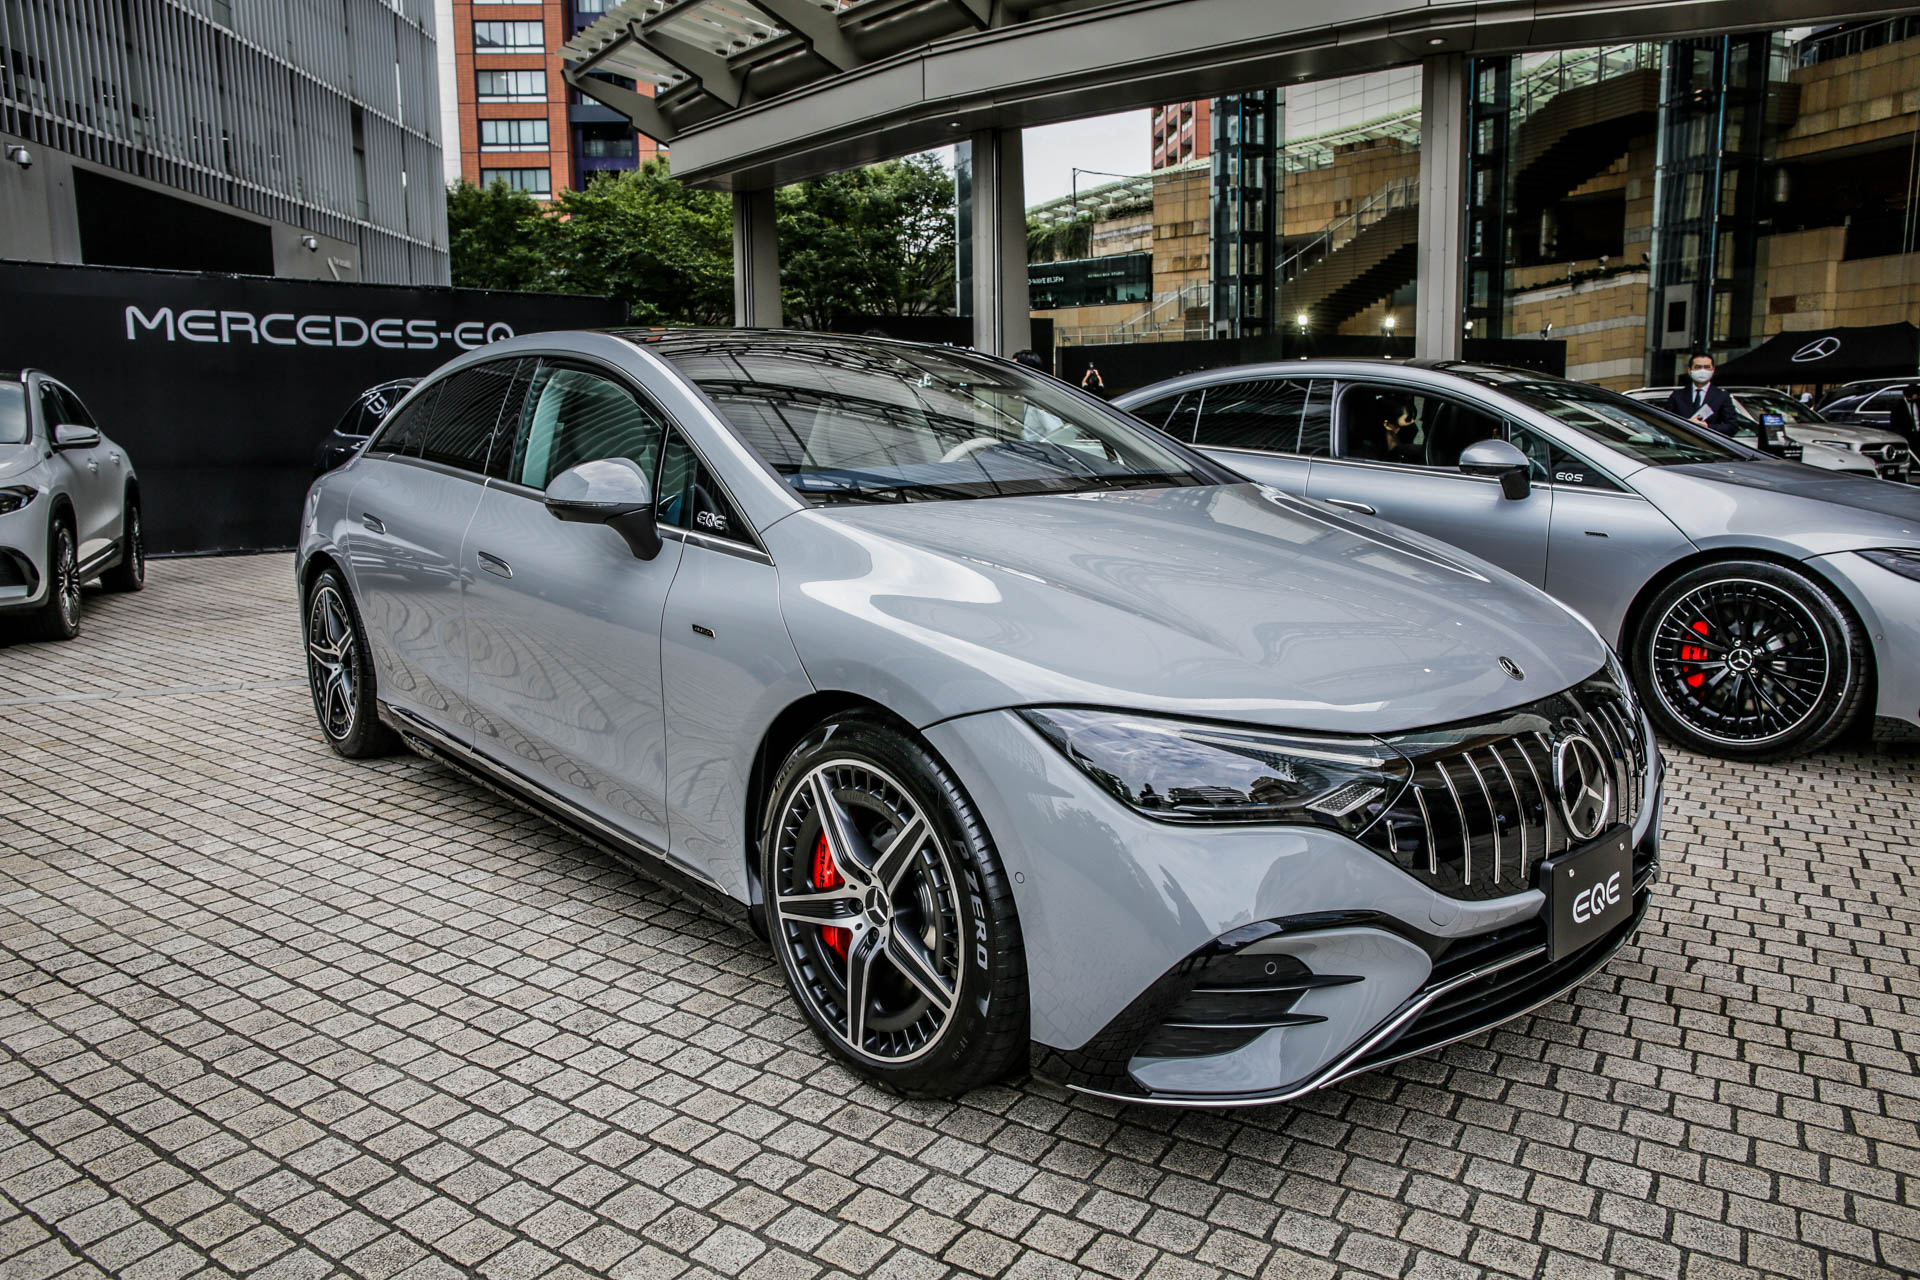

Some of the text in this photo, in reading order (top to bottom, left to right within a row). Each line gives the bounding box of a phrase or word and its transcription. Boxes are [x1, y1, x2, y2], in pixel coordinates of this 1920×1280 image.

[125, 305, 515, 350] MERCEDES-EQ
[1555, 471, 1584, 482] EQS
[697, 511, 727, 531] EQE
[952, 839, 989, 971] P ZERO
[1572, 871, 1621, 924] EQE
